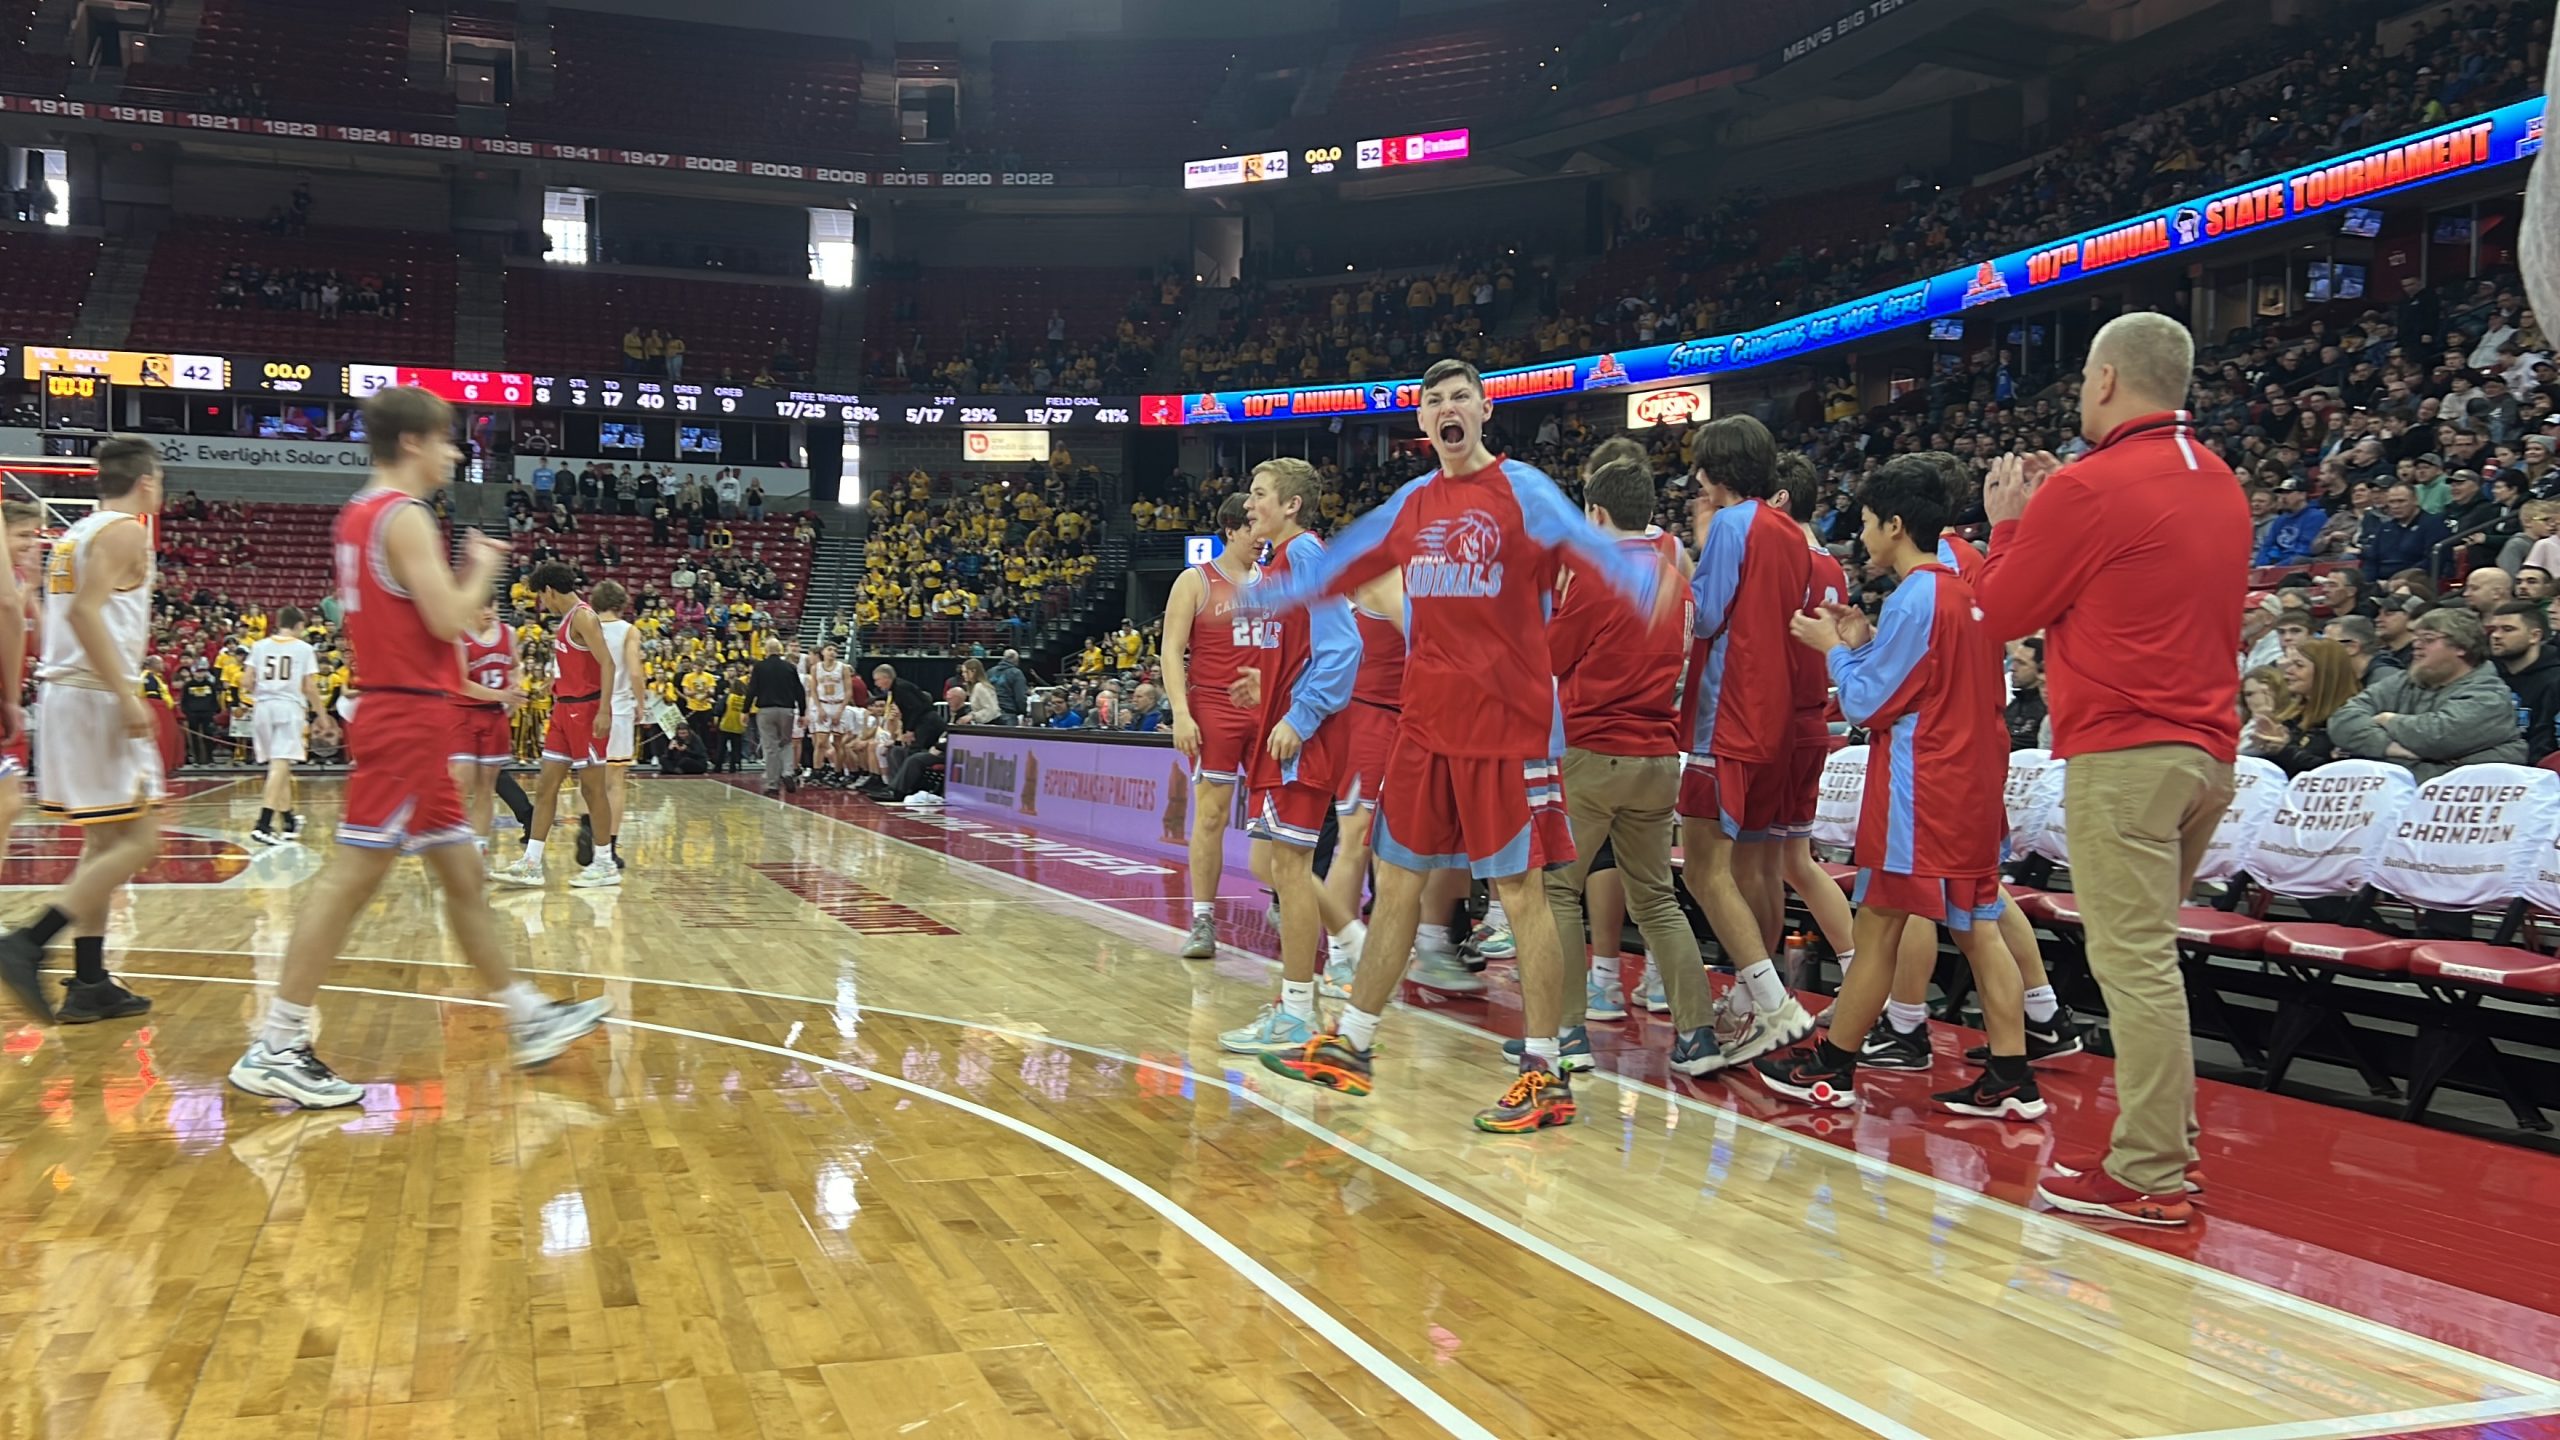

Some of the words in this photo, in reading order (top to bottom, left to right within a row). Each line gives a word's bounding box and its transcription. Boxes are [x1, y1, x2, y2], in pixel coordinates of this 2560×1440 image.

[1783, 27, 1833, 63] MEN'S
[1837, 10, 1865, 36] BIG
[30, 99, 85, 116] 1916
[110, 106, 164, 123] 1918
[187, 113, 240, 131] 1921
[262, 120, 318, 137] 1923
[337, 126, 391, 143] 1924
[409, 132, 462, 149] 1929
[481, 138, 533, 155] 1935
[552, 145, 600, 161] 1941
[620, 151, 670, 167] 1947
[685, 156, 737, 173] 2002
[751, 161, 803, 178] 2003
[816, 168, 867, 184] 2008
[882, 172, 929, 186] 2015
[942, 172, 992, 186] 2020
[1002, 172, 1054, 186] 2022
[1305, 147, 1342, 163] 00.0
[1361, 147, 1381, 161] 52
[1266, 159, 1285, 172] 42
[1311, 162, 1335, 173] 2ND
[2082, 216, 2170, 271] ANNUAL
[2205, 181, 2285, 237] STATE
[2290, 121, 2493, 213] TOURNAMENT
[184, 365, 212, 380] 42
[264, 363, 311, 379] 00.0
[273, 380, 303, 391] 2ND
[363, 375, 387, 390] 52
[452, 371, 489, 383] FOULS
[500, 374, 523, 385] TOL
[533, 377, 554, 387] AST
[569, 378, 589, 389] STL
[604, 380, 620, 390] TO
[638, 383, 661, 394] REB
[1482, 366, 1576, 399] URNAMENT
[464, 384, 478, 399] 6
[504, 386, 520, 401] 0
[536, 388, 550, 403] 8
[572, 390, 586, 405] 3
[602, 391, 623, 407] 17
[637, 394, 664, 409] 40
[676, 395, 697, 411] 31
[721, 397, 736, 412] 9
[790, 392, 814, 402] FREE
[816, 393, 859, 405] THROWS
[1046, 397, 1073, 406] FIELD
[1074, 397, 1101, 407] GOAL
[1292, 387, 1366, 414] ANNUAL
[776, 402, 826, 418] 17/25
[842, 405, 879, 421] 68%
[906, 407, 943, 424] 5/17
[960, 407, 997, 423] 29%
[1025, 407, 1073, 424] 15/37
[1095, 407, 1129, 423] 41%
[198, 446, 281, 465] Everlight
[285, 449, 334, 464] Solar
[1405, 561, 1504, 597] RDINALS
[264, 655, 291, 681] 50
[1827, 762, 1866, 775] RECOVE
[2293, 776, 2385, 794] RECOVER
[2421, 785, 2528, 802] RECOVER
[2303, 795, 2345, 812] LIKE
[2350, 795, 2363, 810] A
[2274, 809, 2375, 831] CHAMPION
[2432, 805, 2484, 823] LIKE
[2488, 806, 2503, 823] A
[2397, 822, 2516, 844] CHAMPION
[968, 832, 1178, 876] CENTER
